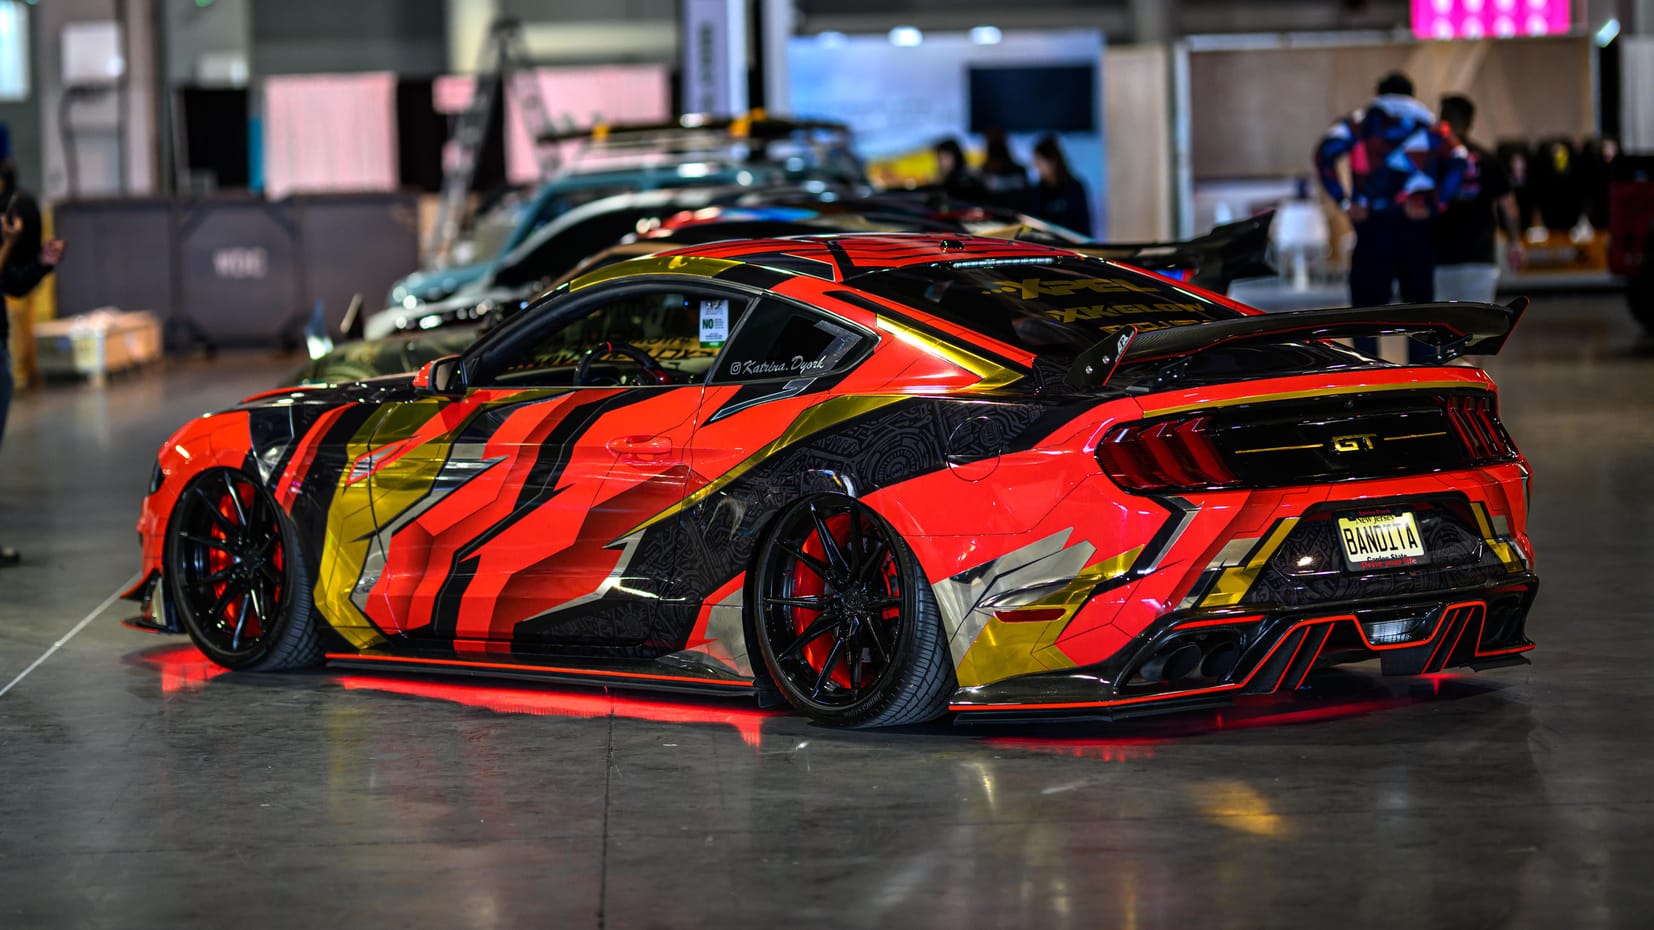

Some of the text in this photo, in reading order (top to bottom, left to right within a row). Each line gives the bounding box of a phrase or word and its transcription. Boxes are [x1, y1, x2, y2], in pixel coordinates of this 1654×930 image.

[991, 278, 1160, 300] XPEL
[702, 318, 714, 330] NO
[1332, 433, 1377, 452] GT
[1343, 523, 1418, 555] BANDITA
